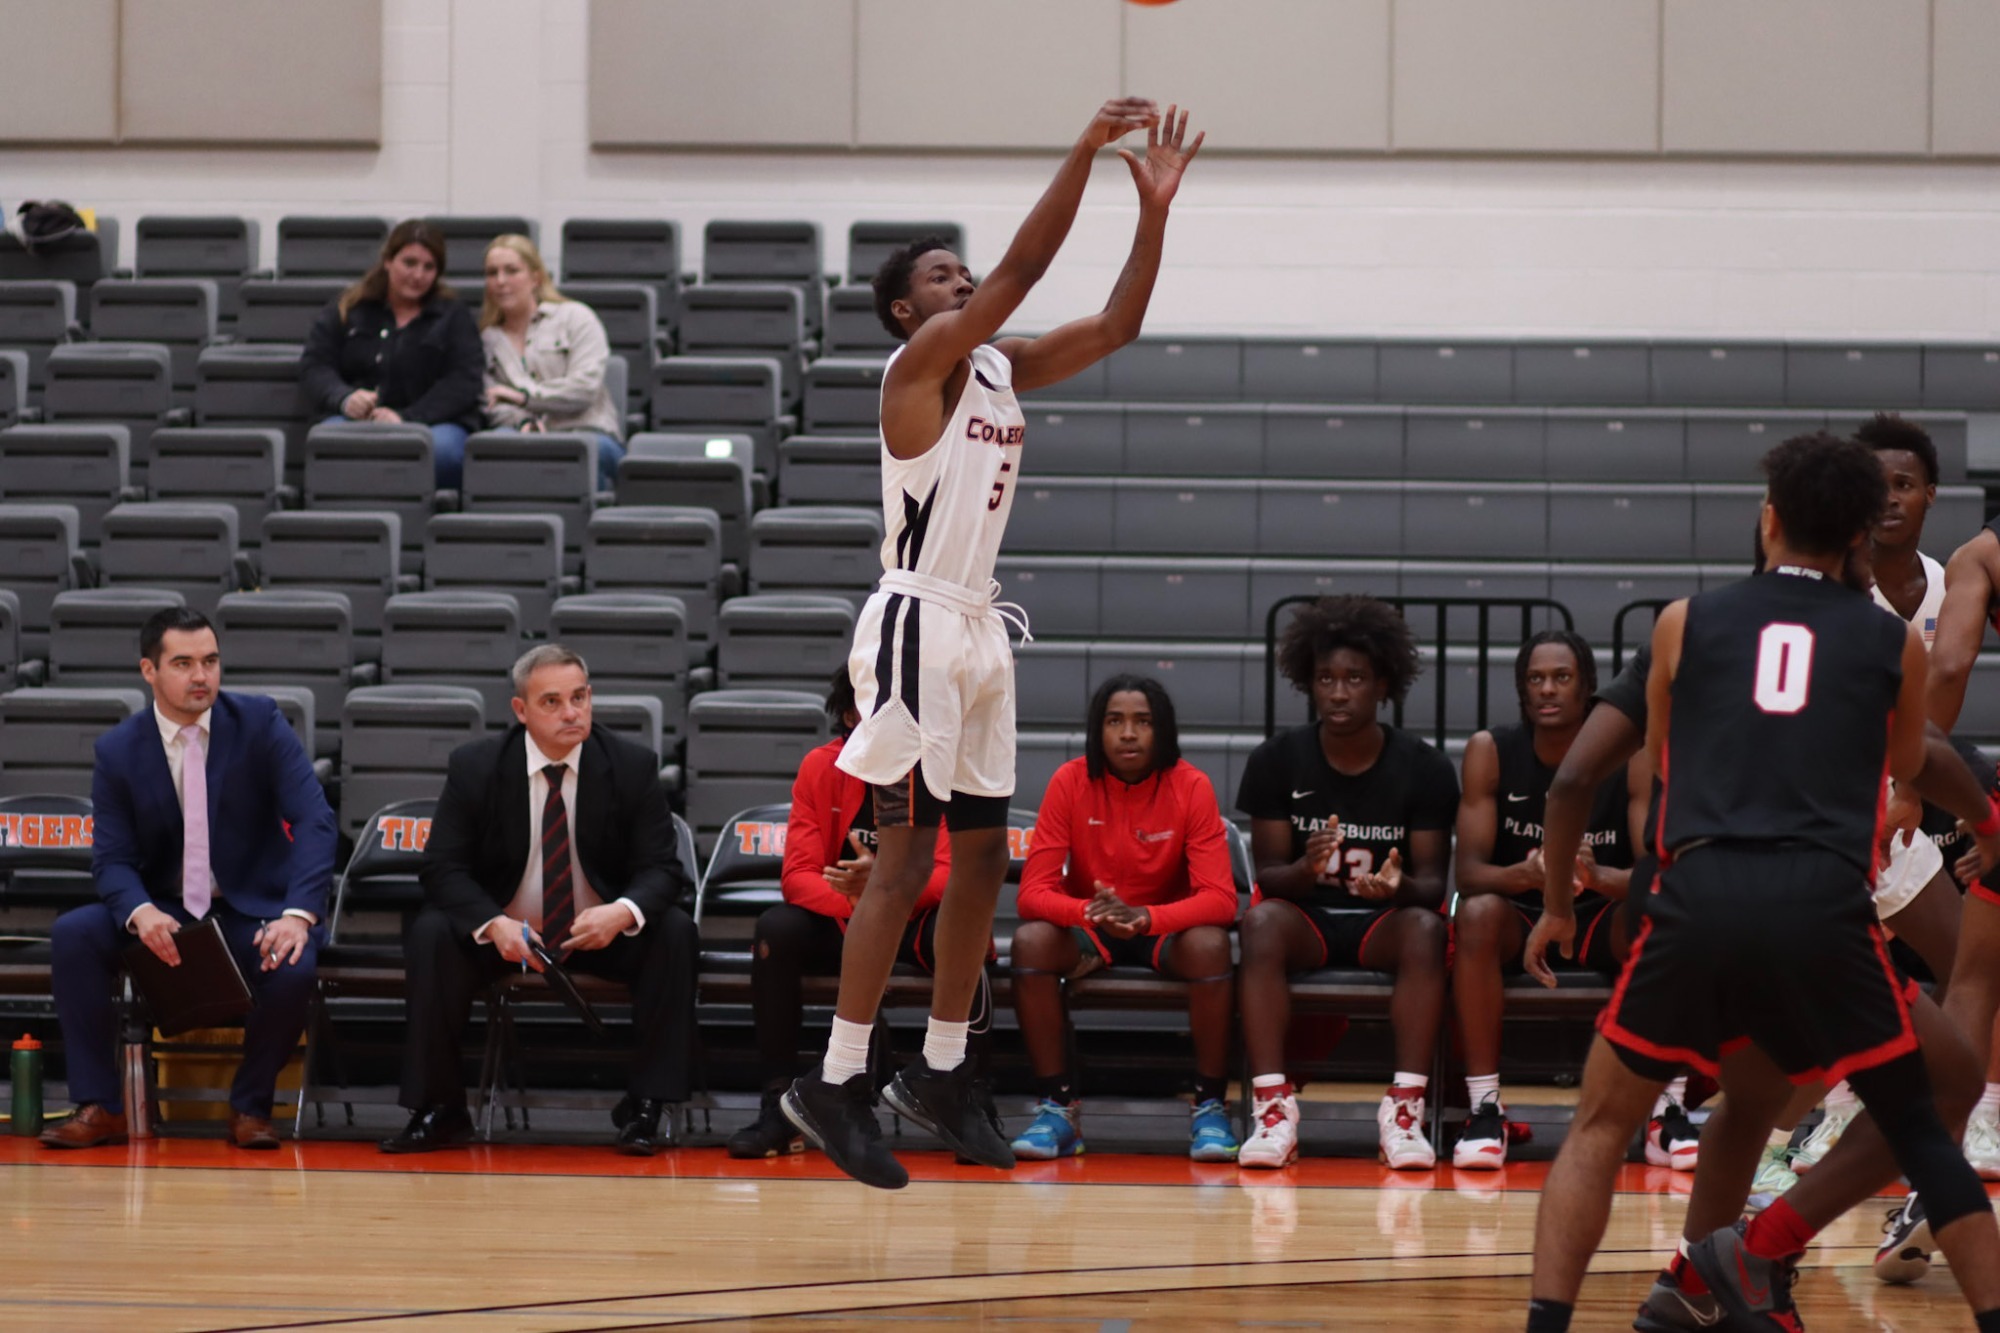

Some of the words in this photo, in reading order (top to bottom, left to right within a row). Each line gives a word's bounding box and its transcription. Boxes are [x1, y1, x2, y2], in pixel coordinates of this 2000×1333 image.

[988, 462, 1011, 511] 5
[1777, 565, 1802, 576] NIKE
[1801, 567, 1823, 581] PRO
[1753, 621, 1815, 715] 0
[1291, 814, 1405, 841] PLATSBURGH
